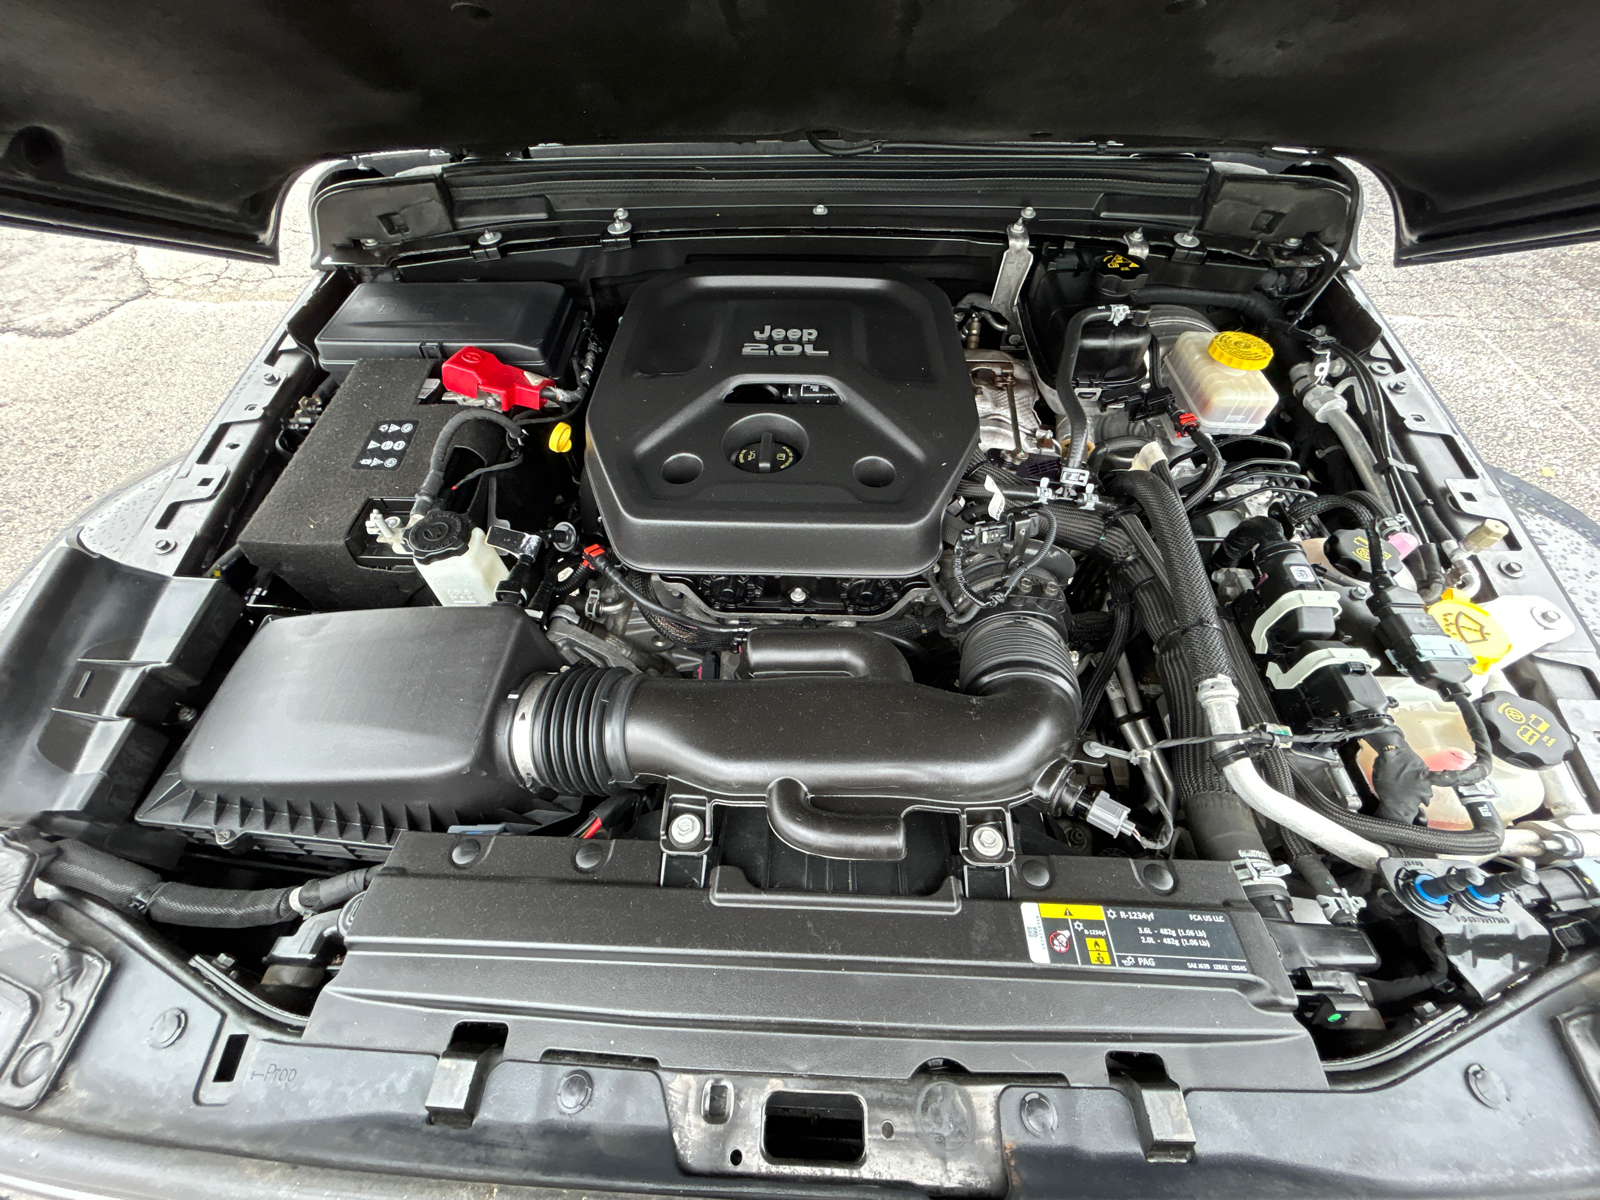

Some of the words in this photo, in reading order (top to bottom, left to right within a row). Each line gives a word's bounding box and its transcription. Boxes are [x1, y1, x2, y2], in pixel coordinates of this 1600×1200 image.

[753, 325, 818, 343] Jeep
[741, 343, 830, 357] 2.0L
[1119, 911, 1155, 922] R-1234yf
[1188, 914, 1203, 922] FCA
[1138, 926, 1152, 935] 3.6L
[1140, 936, 1155, 944] 2.0L
[1137, 957, 1156, 966] PAG
[264, 1063, 297, 1088] Prop
